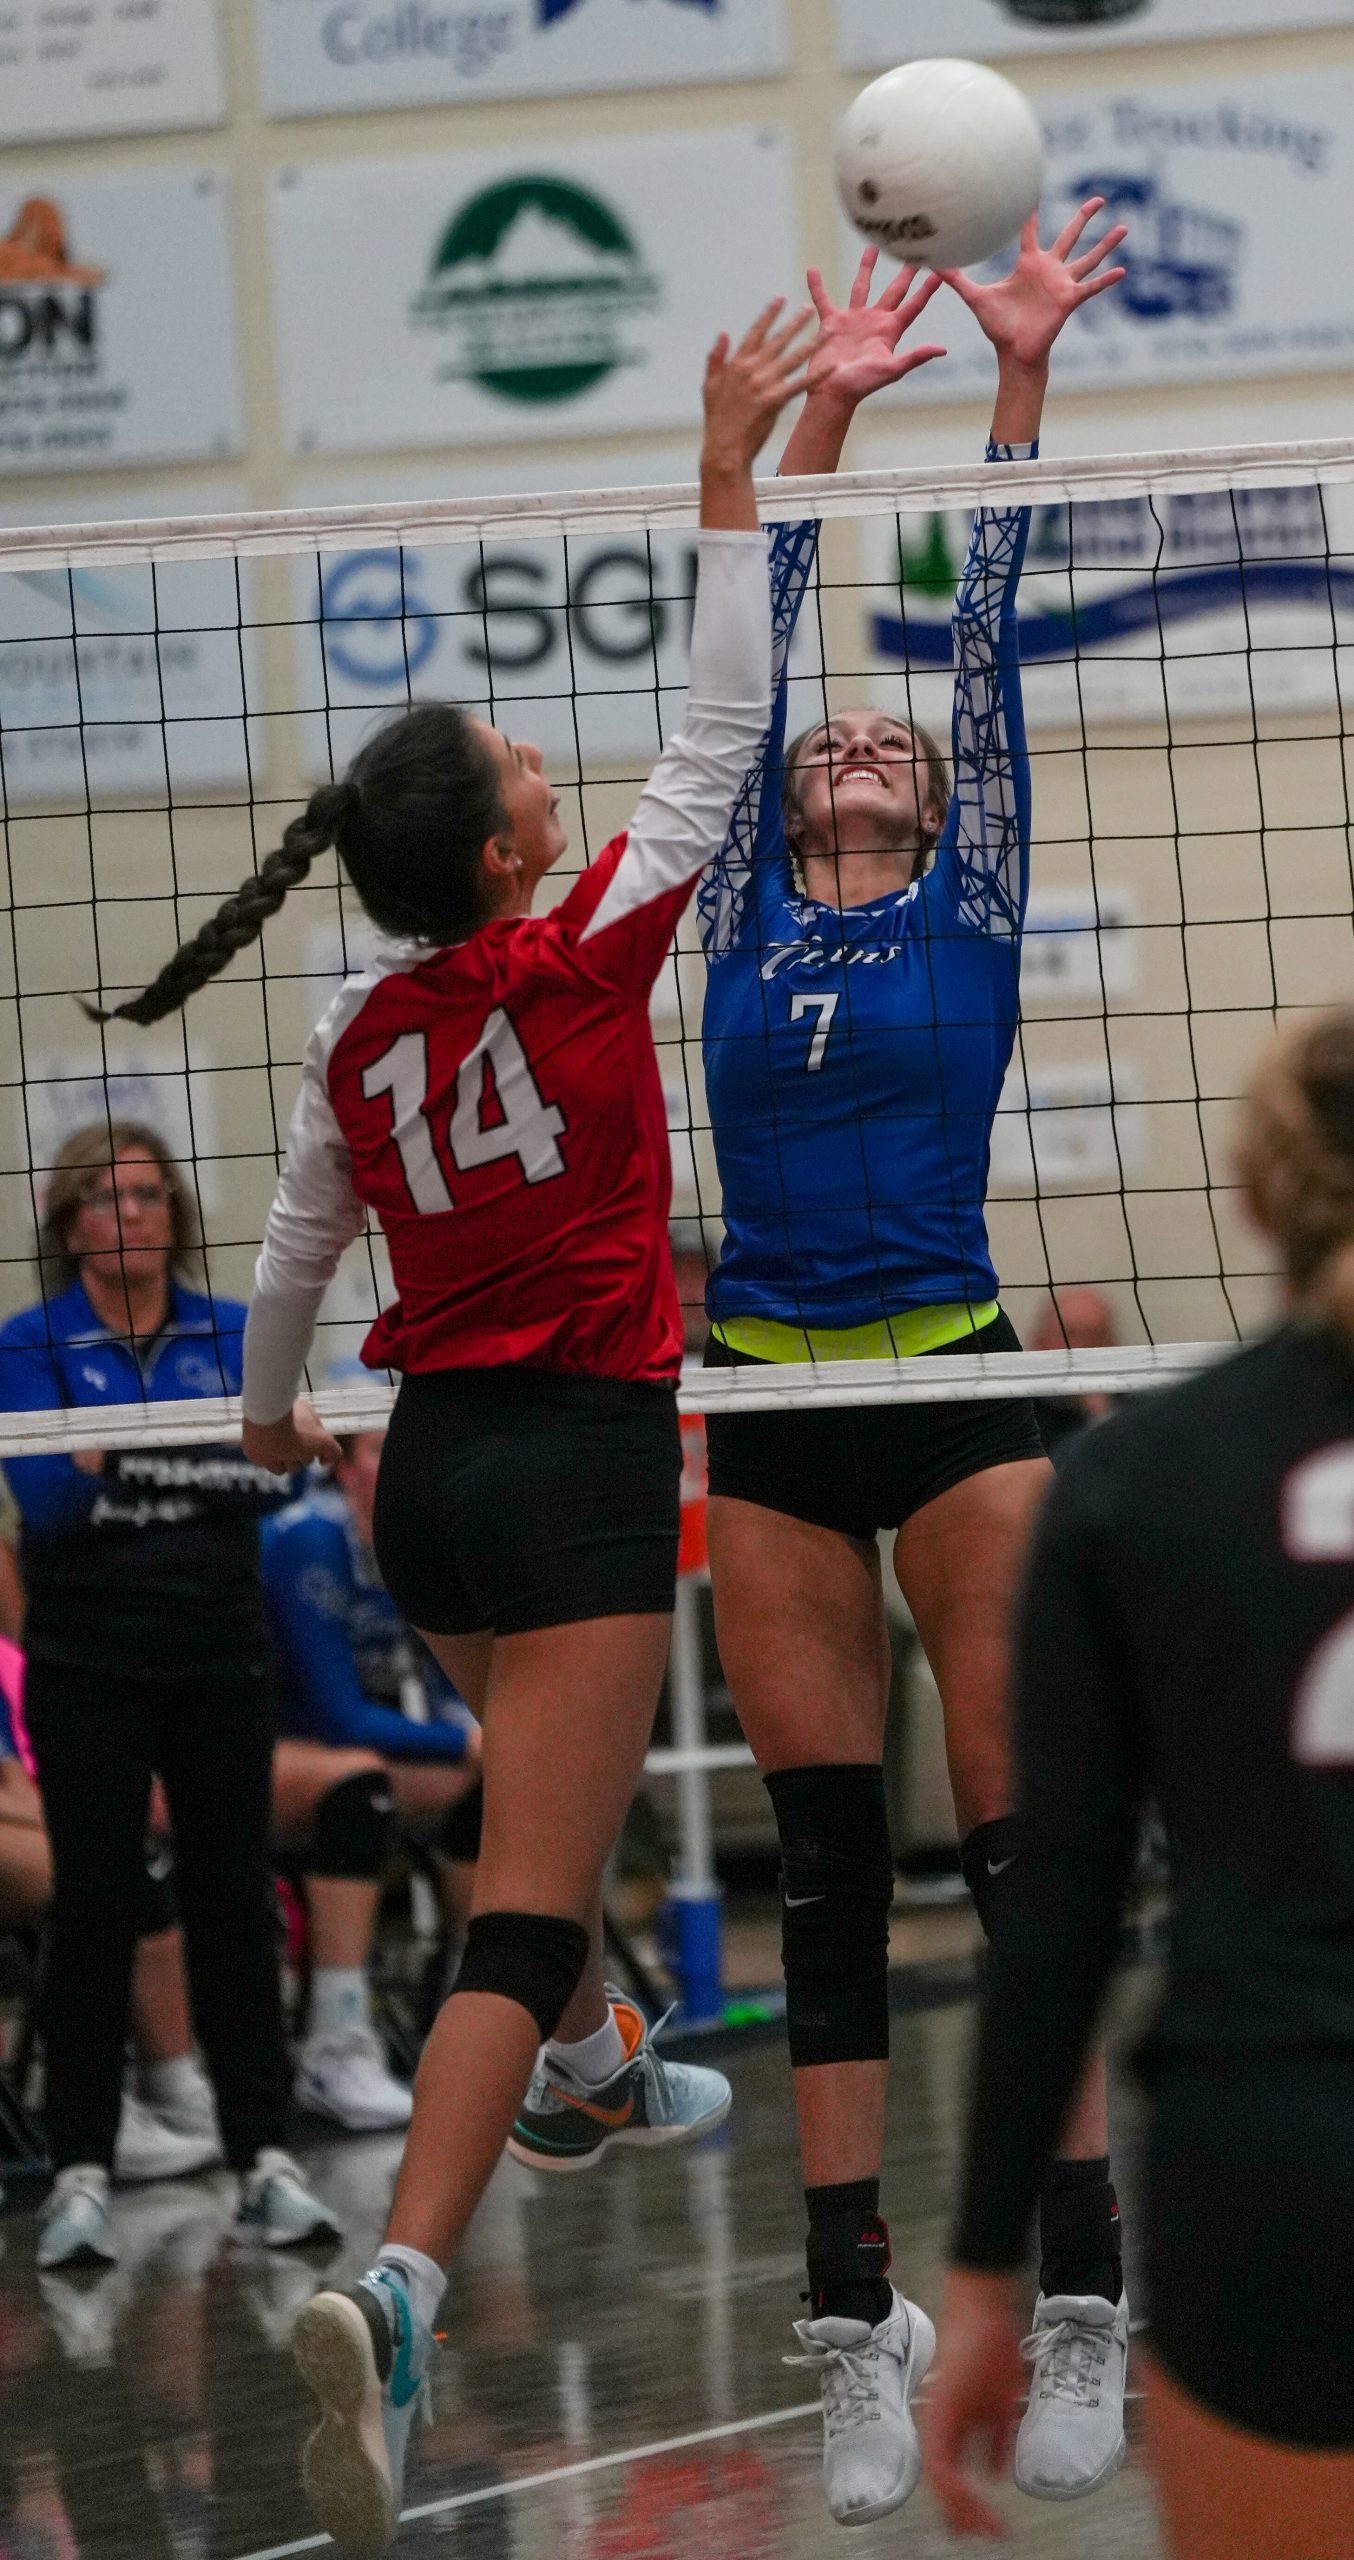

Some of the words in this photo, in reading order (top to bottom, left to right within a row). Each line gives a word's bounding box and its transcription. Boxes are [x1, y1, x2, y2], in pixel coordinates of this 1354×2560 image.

[319, 1, 513, 79] College
[790, 992, 839, 1072] 7
[362, 1007, 568, 1215] 14
